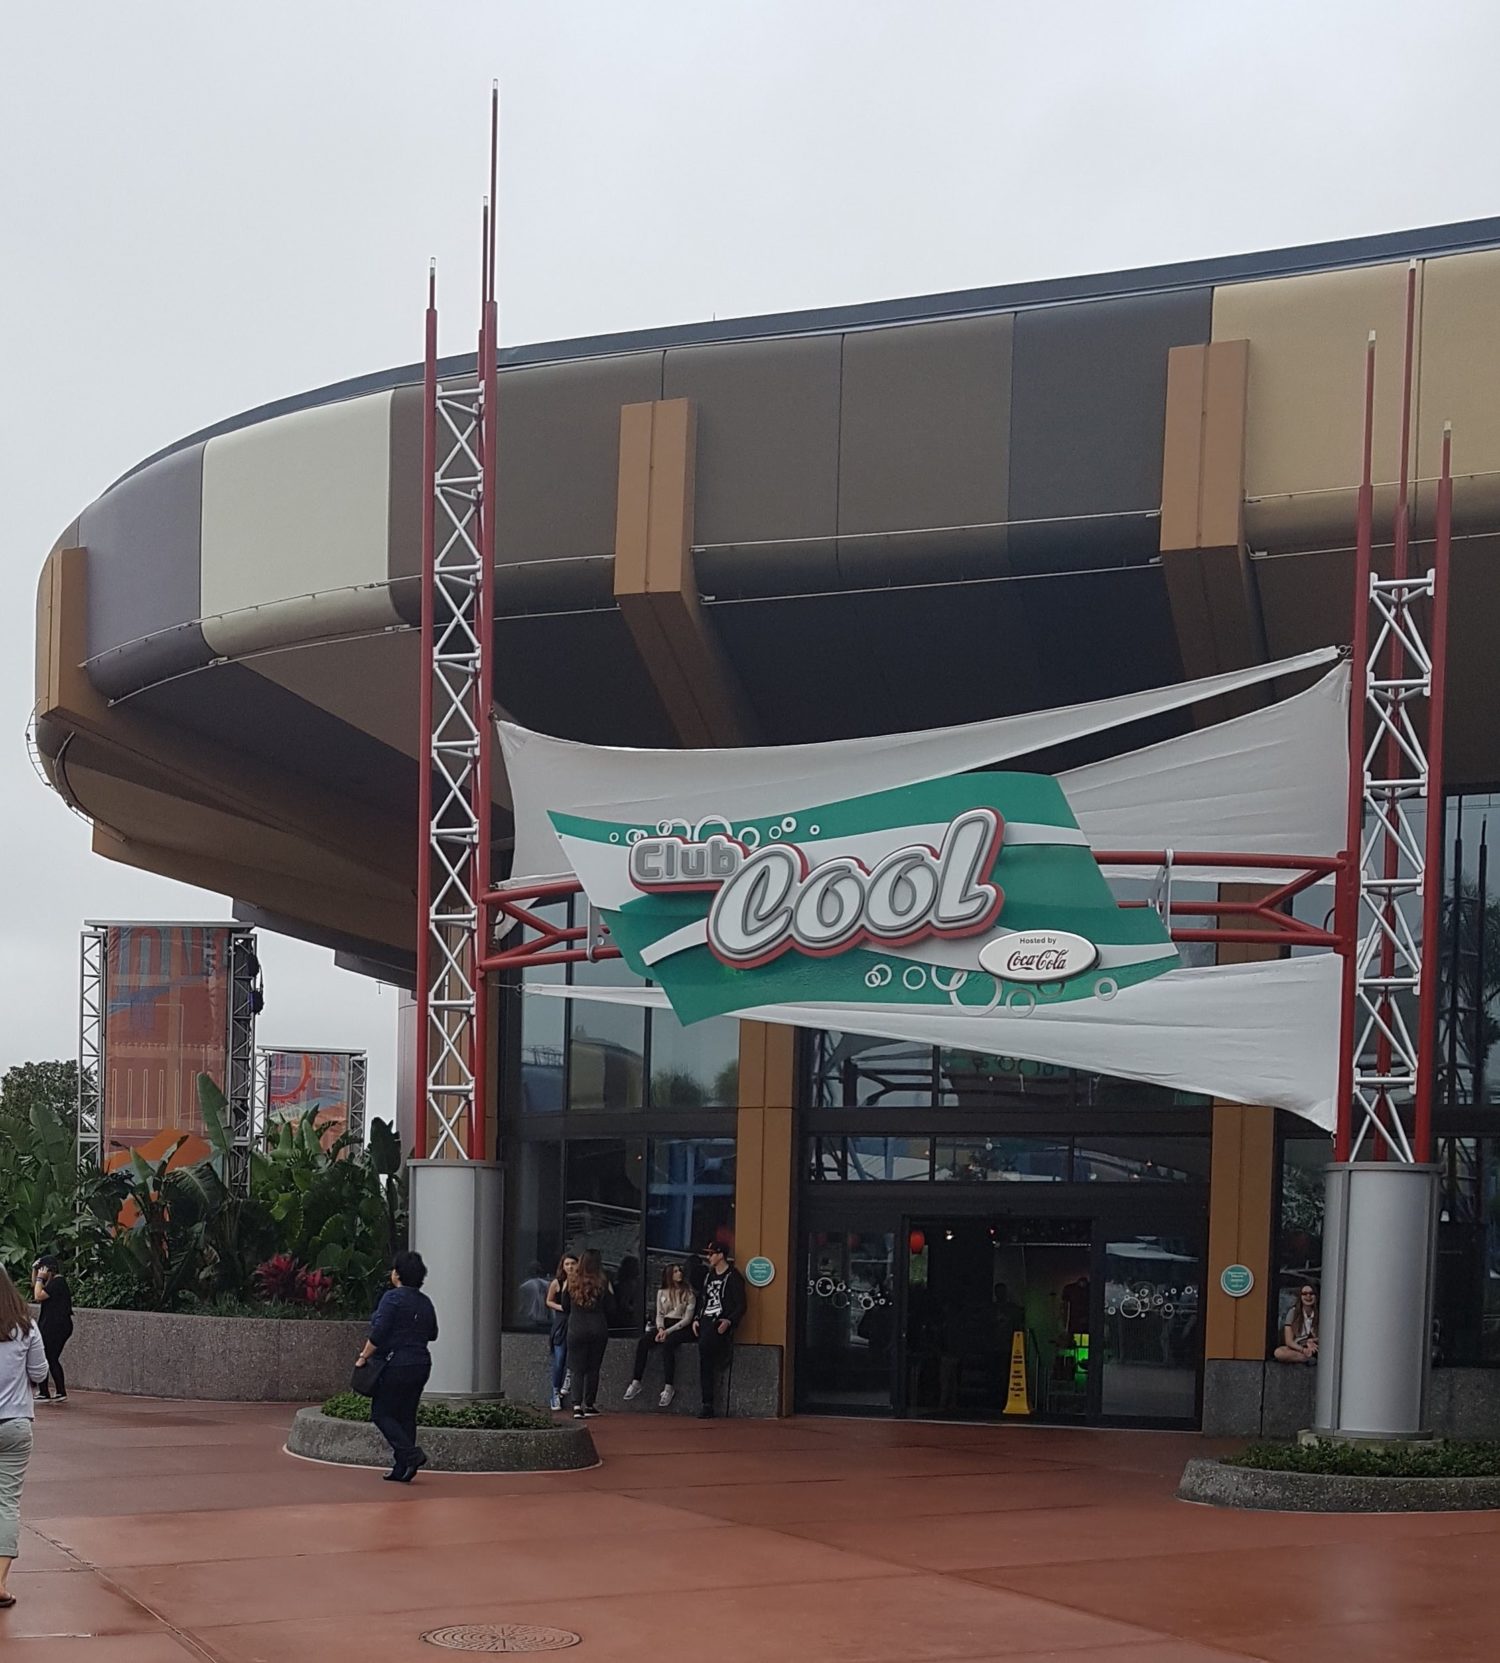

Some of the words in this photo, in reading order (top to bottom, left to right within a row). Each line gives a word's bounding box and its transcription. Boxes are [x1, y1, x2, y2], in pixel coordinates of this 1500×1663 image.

[634, 840, 739, 880] Club
[709, 811, 995, 959] Cool
[1047, 937, 1057, 945] by
